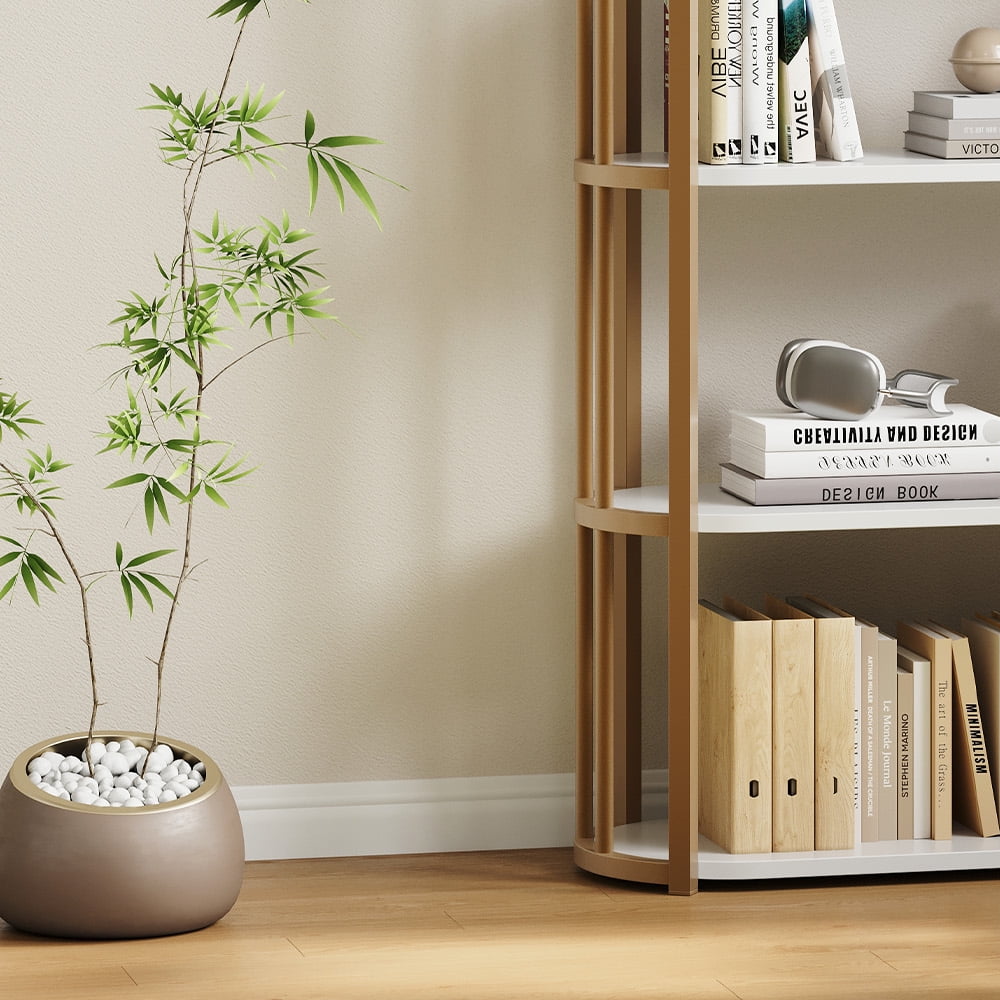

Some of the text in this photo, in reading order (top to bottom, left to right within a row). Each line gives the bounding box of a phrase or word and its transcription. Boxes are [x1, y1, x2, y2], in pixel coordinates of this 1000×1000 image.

[836, 86, 850, 128] WHARTON
[938, 681, 947, 698] The
[938, 704, 946, 719] art
[938, 726, 947, 736] of
[966, 704, 987, 774] MINIMALISM
[882, 700, 892, 788] Le Monde Journal
[938, 744, 947, 759] the
